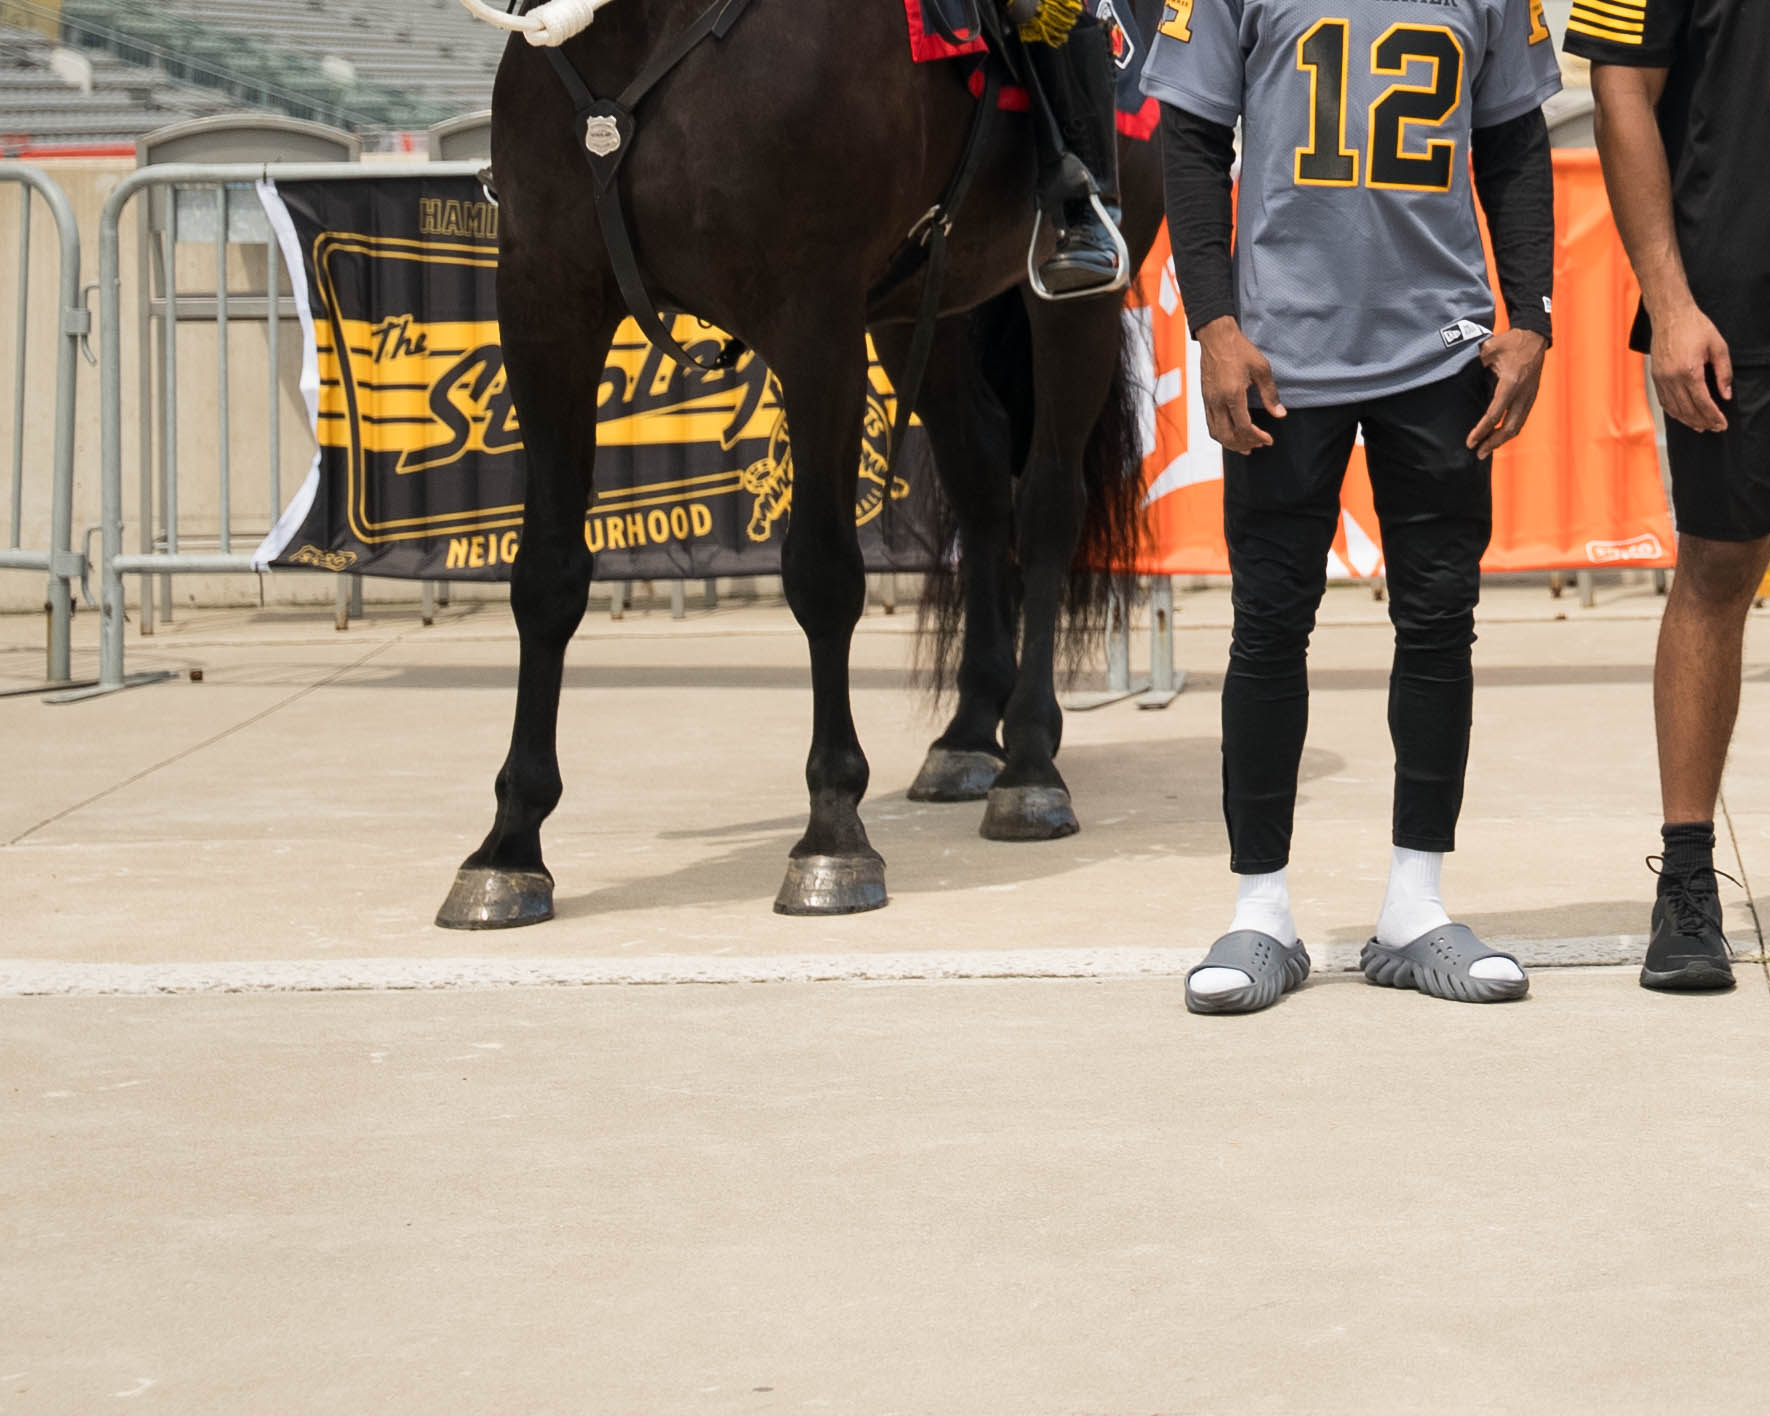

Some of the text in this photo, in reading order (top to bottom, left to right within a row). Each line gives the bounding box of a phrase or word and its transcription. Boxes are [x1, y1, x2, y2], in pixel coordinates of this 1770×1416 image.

[1295, 17, 1463, 192] 12
[419, 196, 499, 240] HAMI
[371, 313, 429, 364] The
[445, 503, 713, 570] NEIGURHOOD
